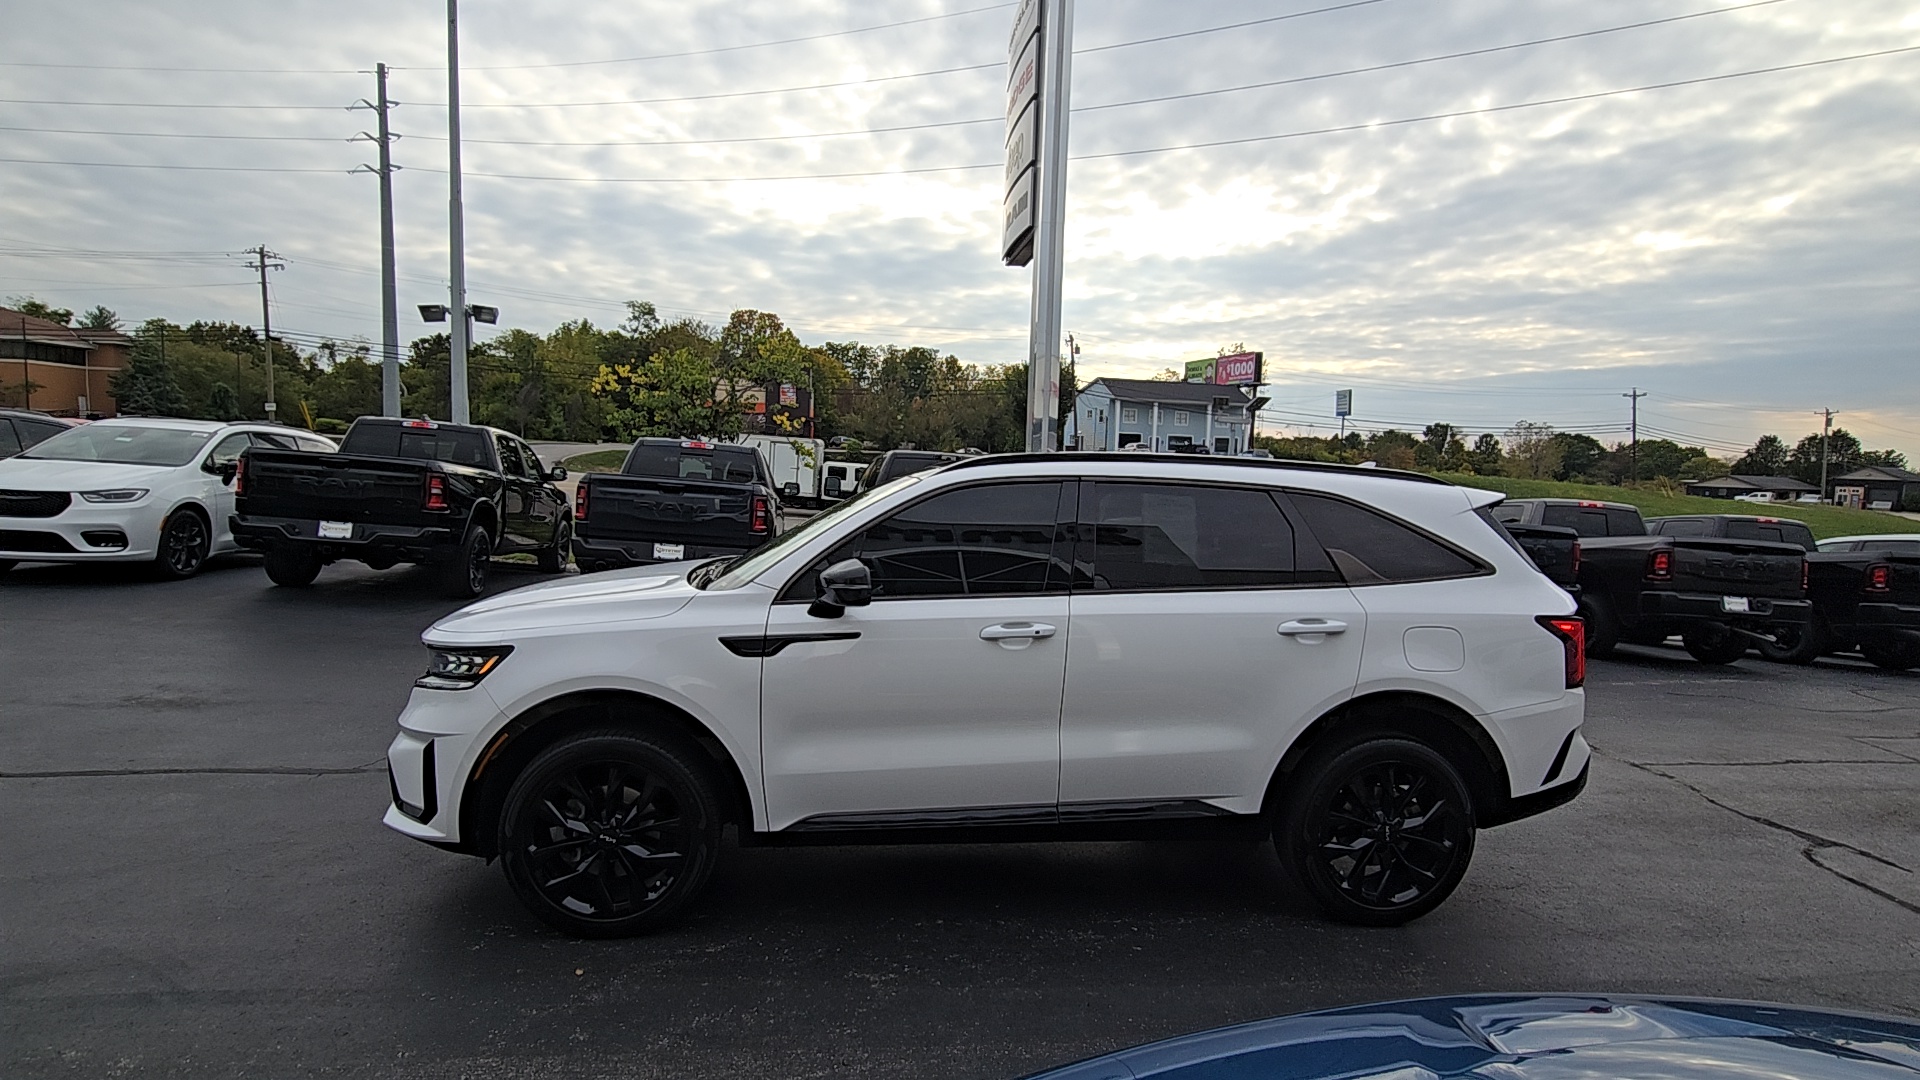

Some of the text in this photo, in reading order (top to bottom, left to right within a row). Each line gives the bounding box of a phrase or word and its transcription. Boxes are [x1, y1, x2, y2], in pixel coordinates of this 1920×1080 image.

[1006, 190, 1028, 232] RAM
[293, 475, 375, 496] RAM
[633, 499, 708, 520] RAM
[1705, 557, 1776, 576] RAM
